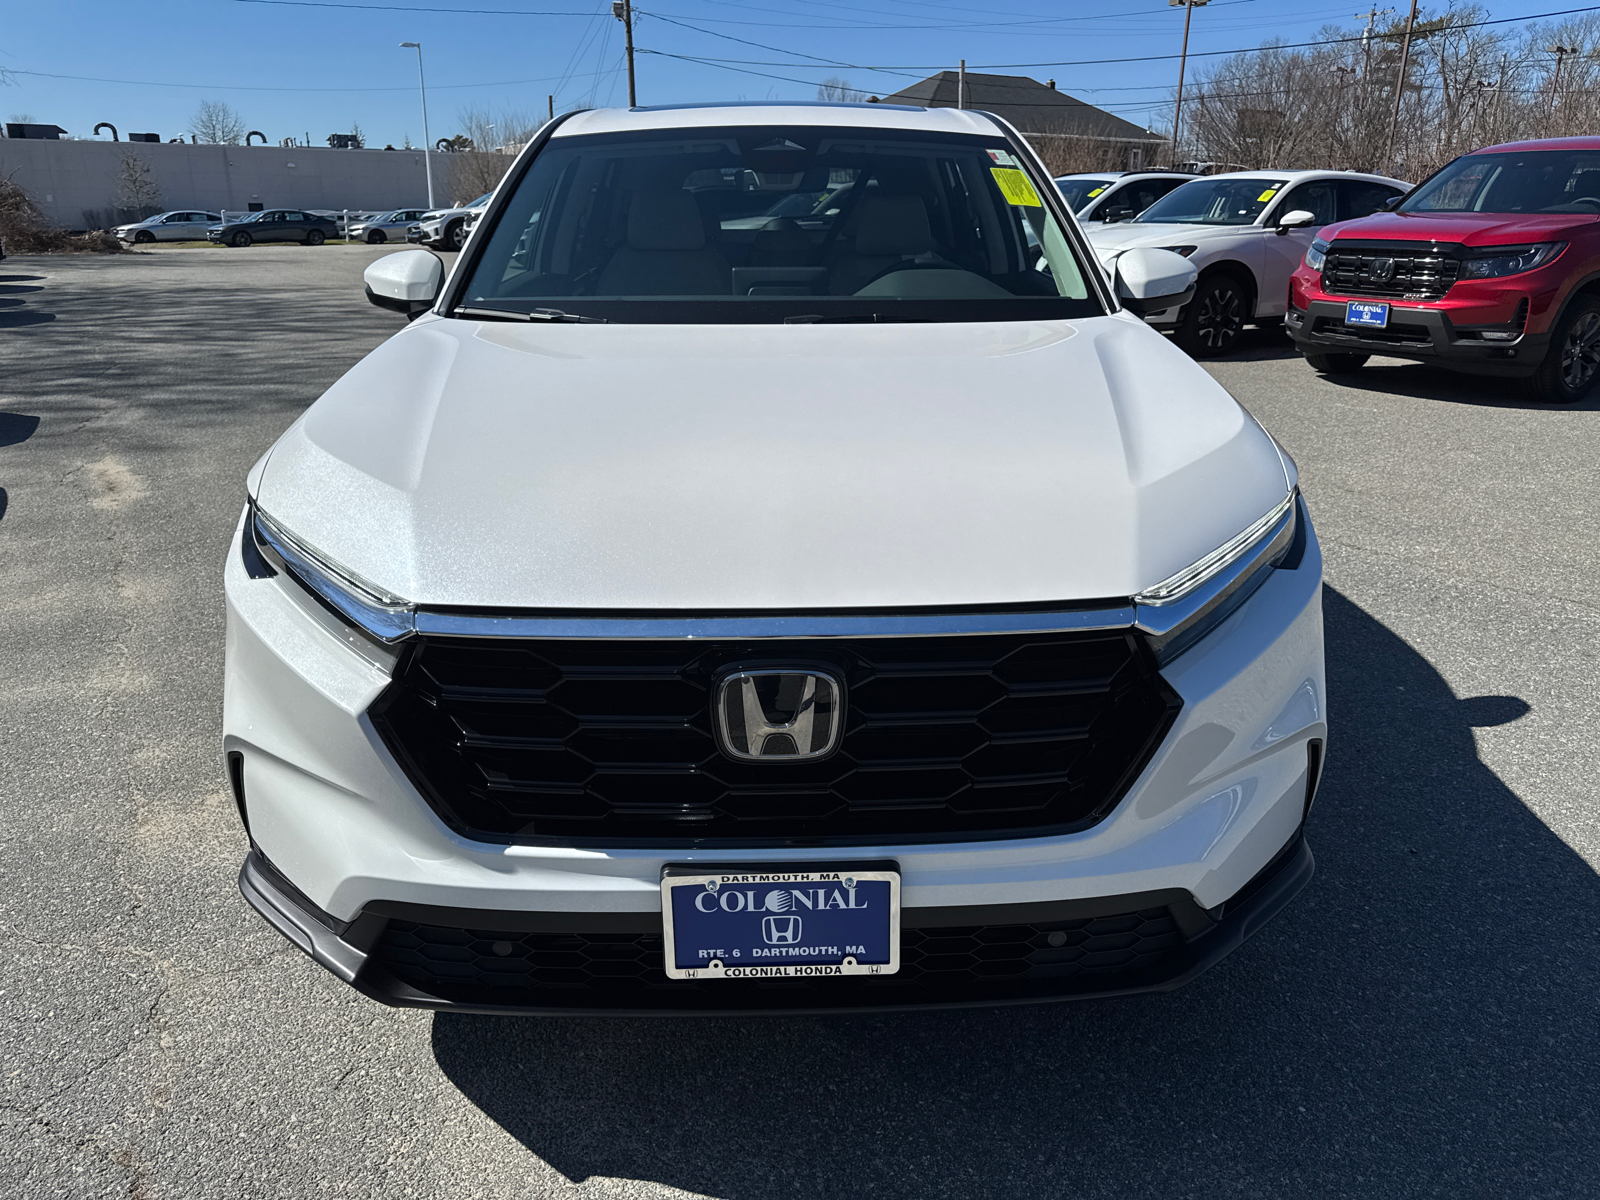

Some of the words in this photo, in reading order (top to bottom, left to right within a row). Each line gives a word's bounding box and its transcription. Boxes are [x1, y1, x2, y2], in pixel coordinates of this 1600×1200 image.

[819, 873, 841, 881] MA
[694, 887, 868, 913] COLONIAL
[698, 949, 729, 959] RTE.
[732, 948, 741, 958] 6
[752, 946, 842, 957] DARTMOUTH,
[845, 945, 867, 955] MA
[724, 968, 793, 977] COLONIAL
[794, 966, 843, 976] HONDA
